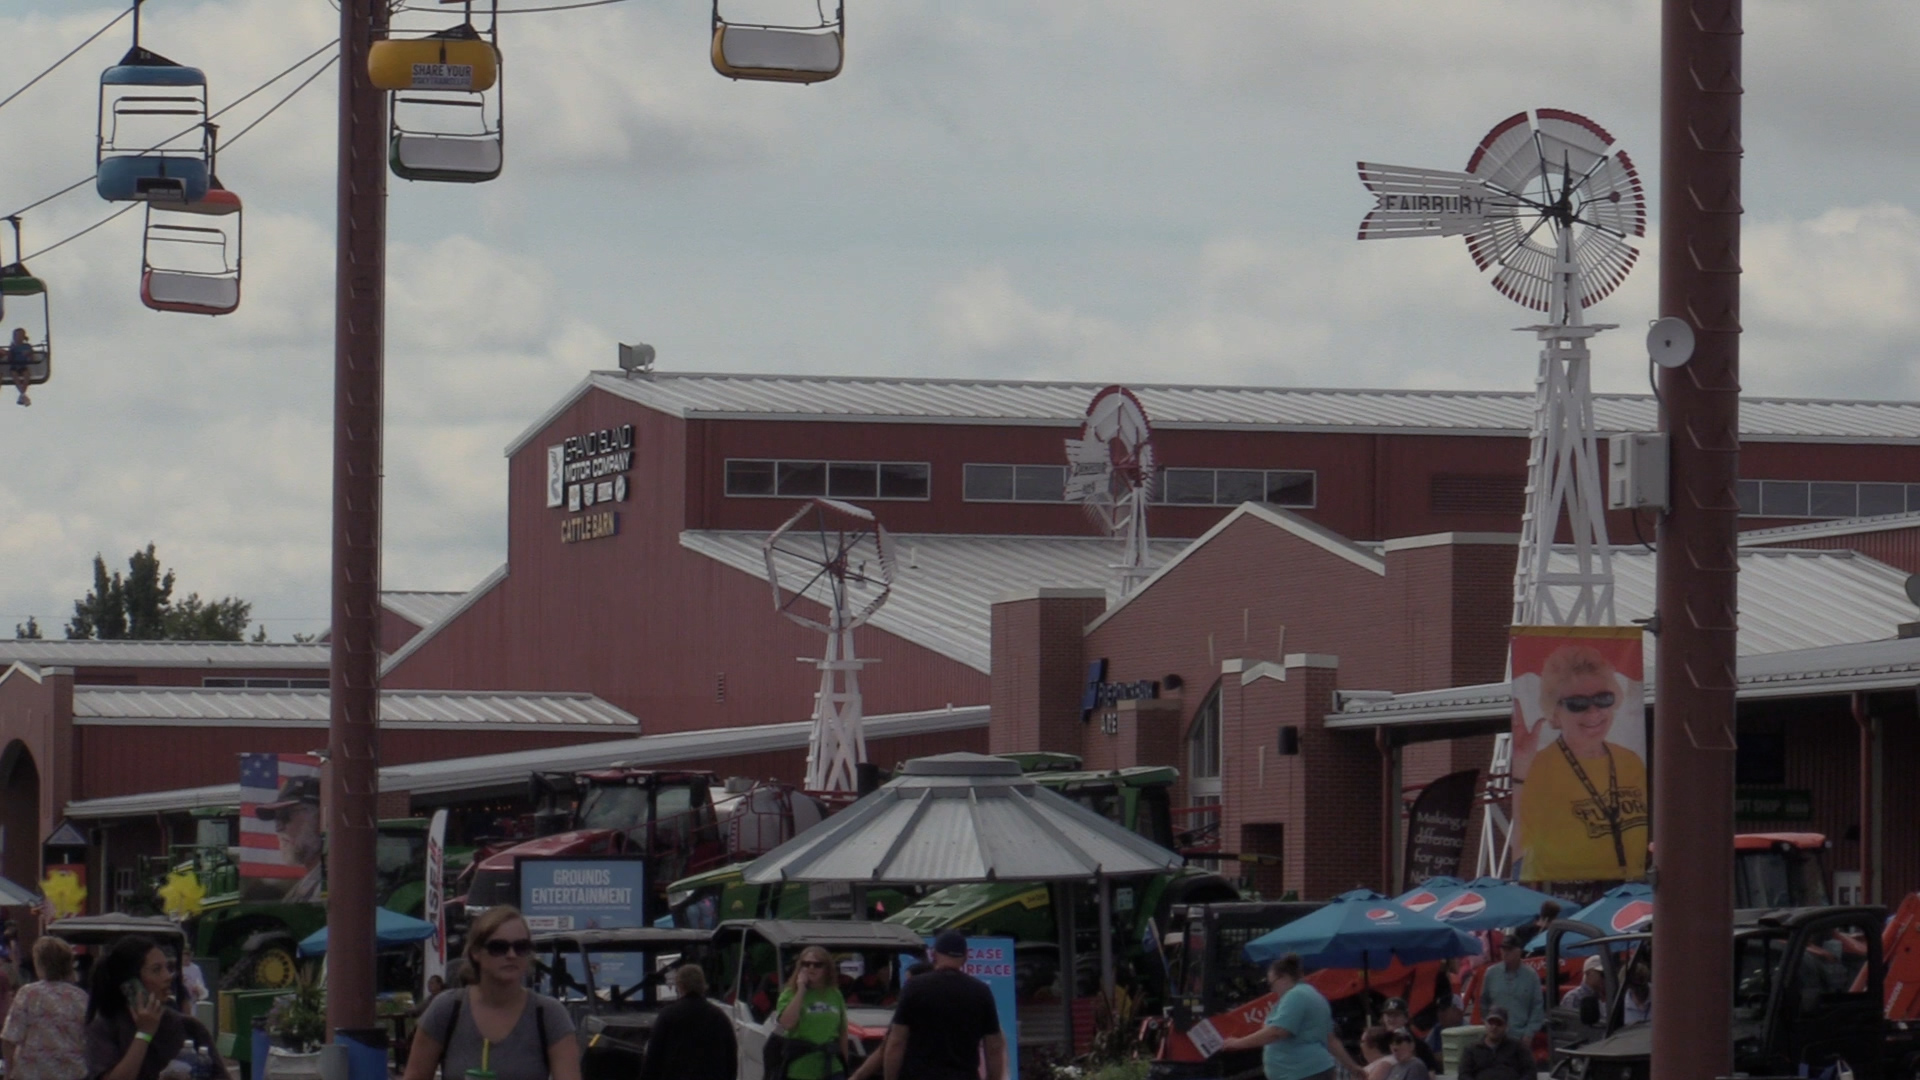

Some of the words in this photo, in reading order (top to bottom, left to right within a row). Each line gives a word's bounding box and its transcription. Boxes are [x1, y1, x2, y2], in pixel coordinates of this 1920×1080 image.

[412, 64, 444, 76] SHARE
[447, 65, 471, 77] YOUR
[1385, 195, 1485, 214] FAIRBURY
[564, 460, 592, 483] MOTOR
[592, 450, 631, 478] COMPANY
[561, 516, 591, 544] CATTLE
[592, 511, 615, 539] BARN
[1416, 809, 1461, 831] Making
[1414, 826, 1464, 848] differenc
[1413, 847, 1433, 863] for
[553, 869, 611, 886] GROUNDS
[531, 887, 633, 905] ENTERTAINMENT
[966, 948, 1004, 960] CASE
[961, 964, 1012, 976] RFACE
